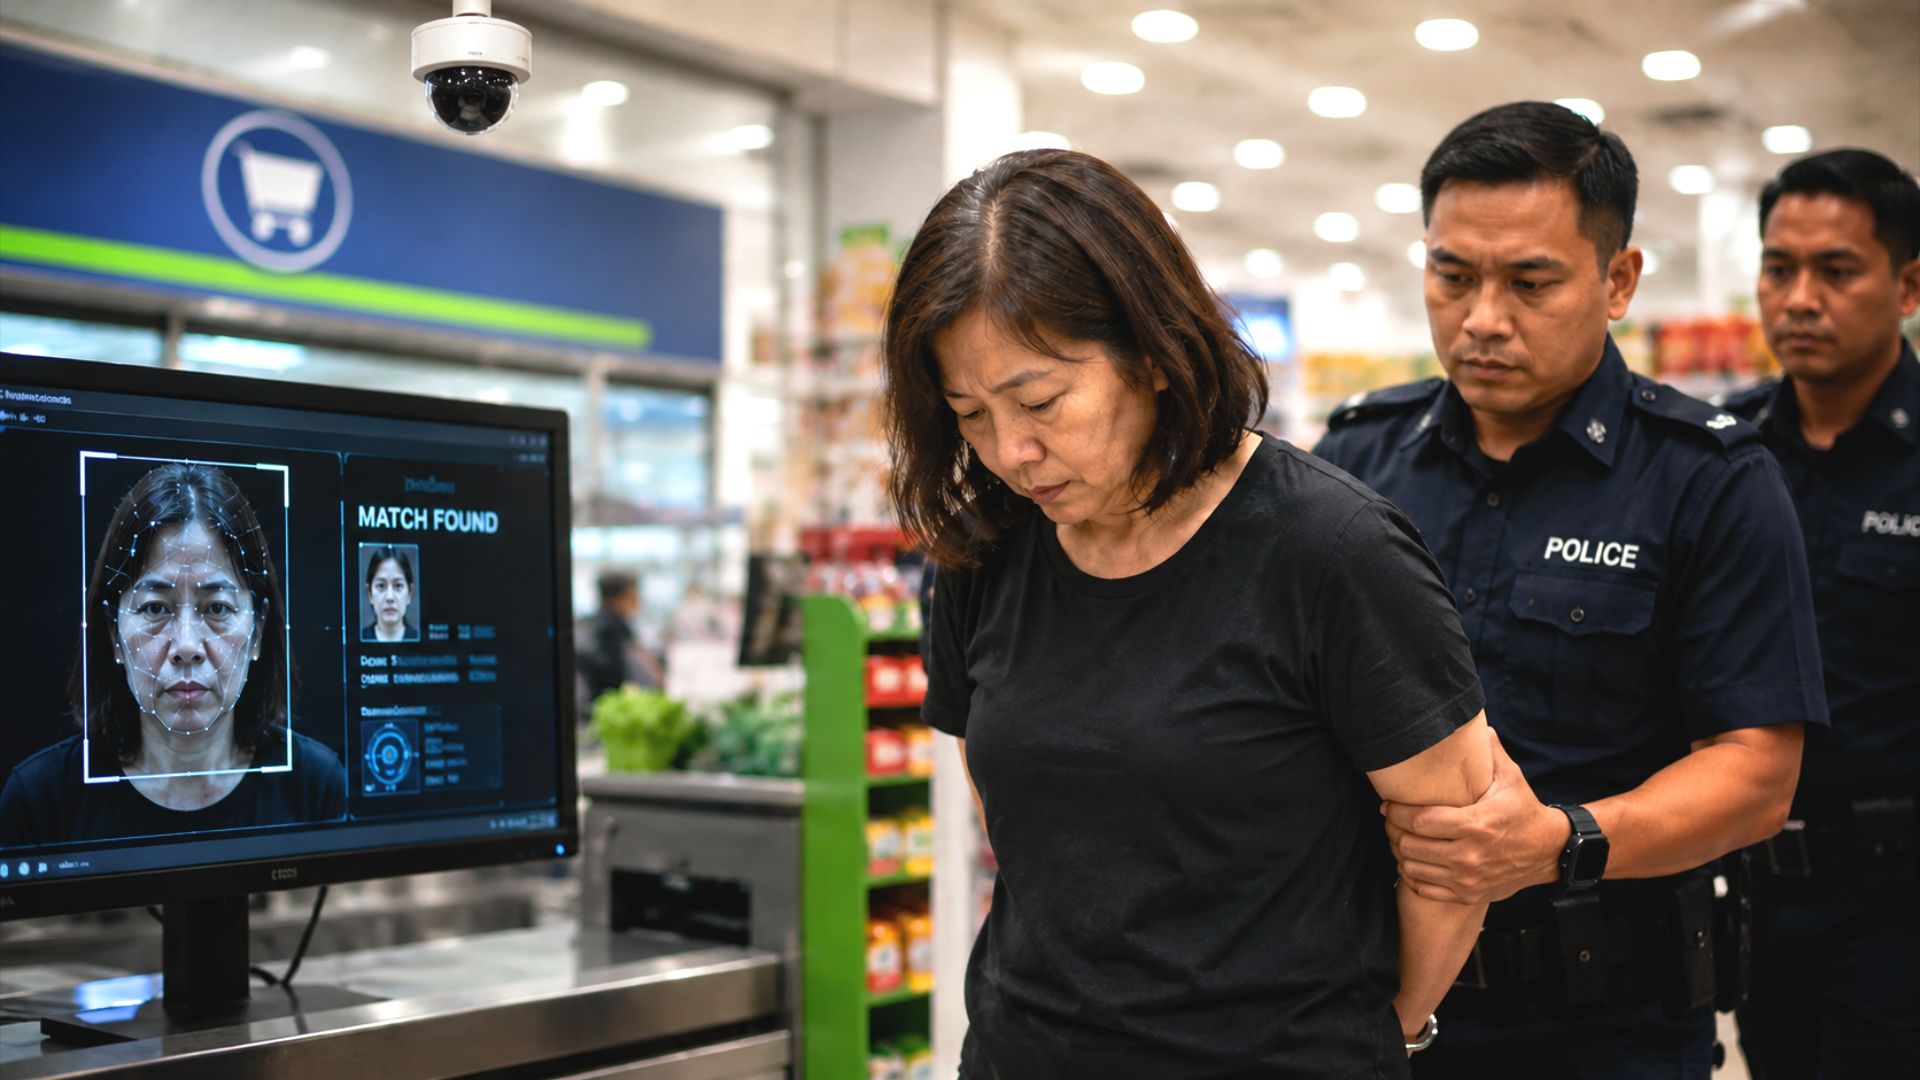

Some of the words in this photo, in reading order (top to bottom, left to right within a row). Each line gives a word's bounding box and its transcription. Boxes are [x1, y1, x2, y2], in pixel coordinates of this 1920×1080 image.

[358, 505, 428, 530] MATCH
[433, 508, 498, 533] FOUND
[1544, 537, 1639, 569] POLICE
